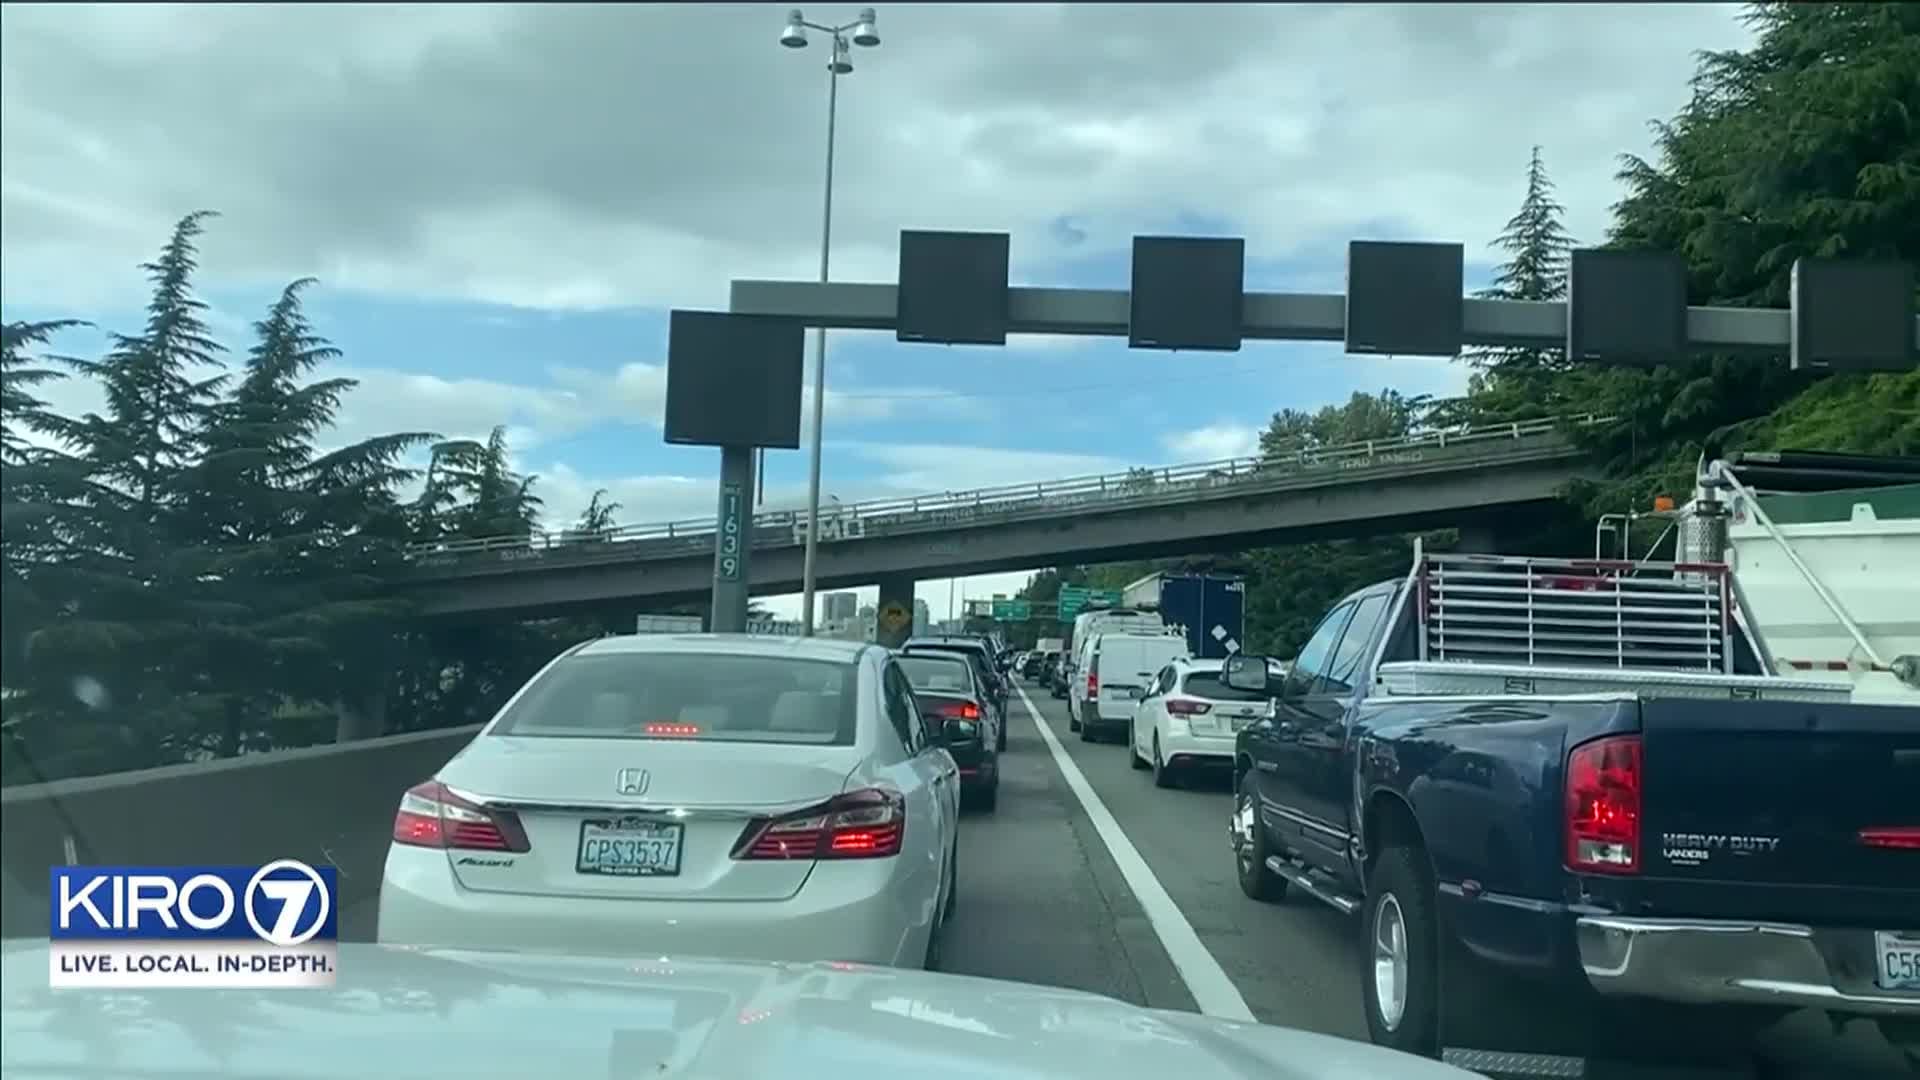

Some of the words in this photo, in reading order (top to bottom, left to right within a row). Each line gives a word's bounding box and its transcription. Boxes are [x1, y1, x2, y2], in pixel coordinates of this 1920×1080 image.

[723, 496, 738, 576] 1639
[584, 840, 674, 866] CPS3537
[1663, 833, 1726, 848] HEAVY
[1730, 836, 1780, 851] DUTY
